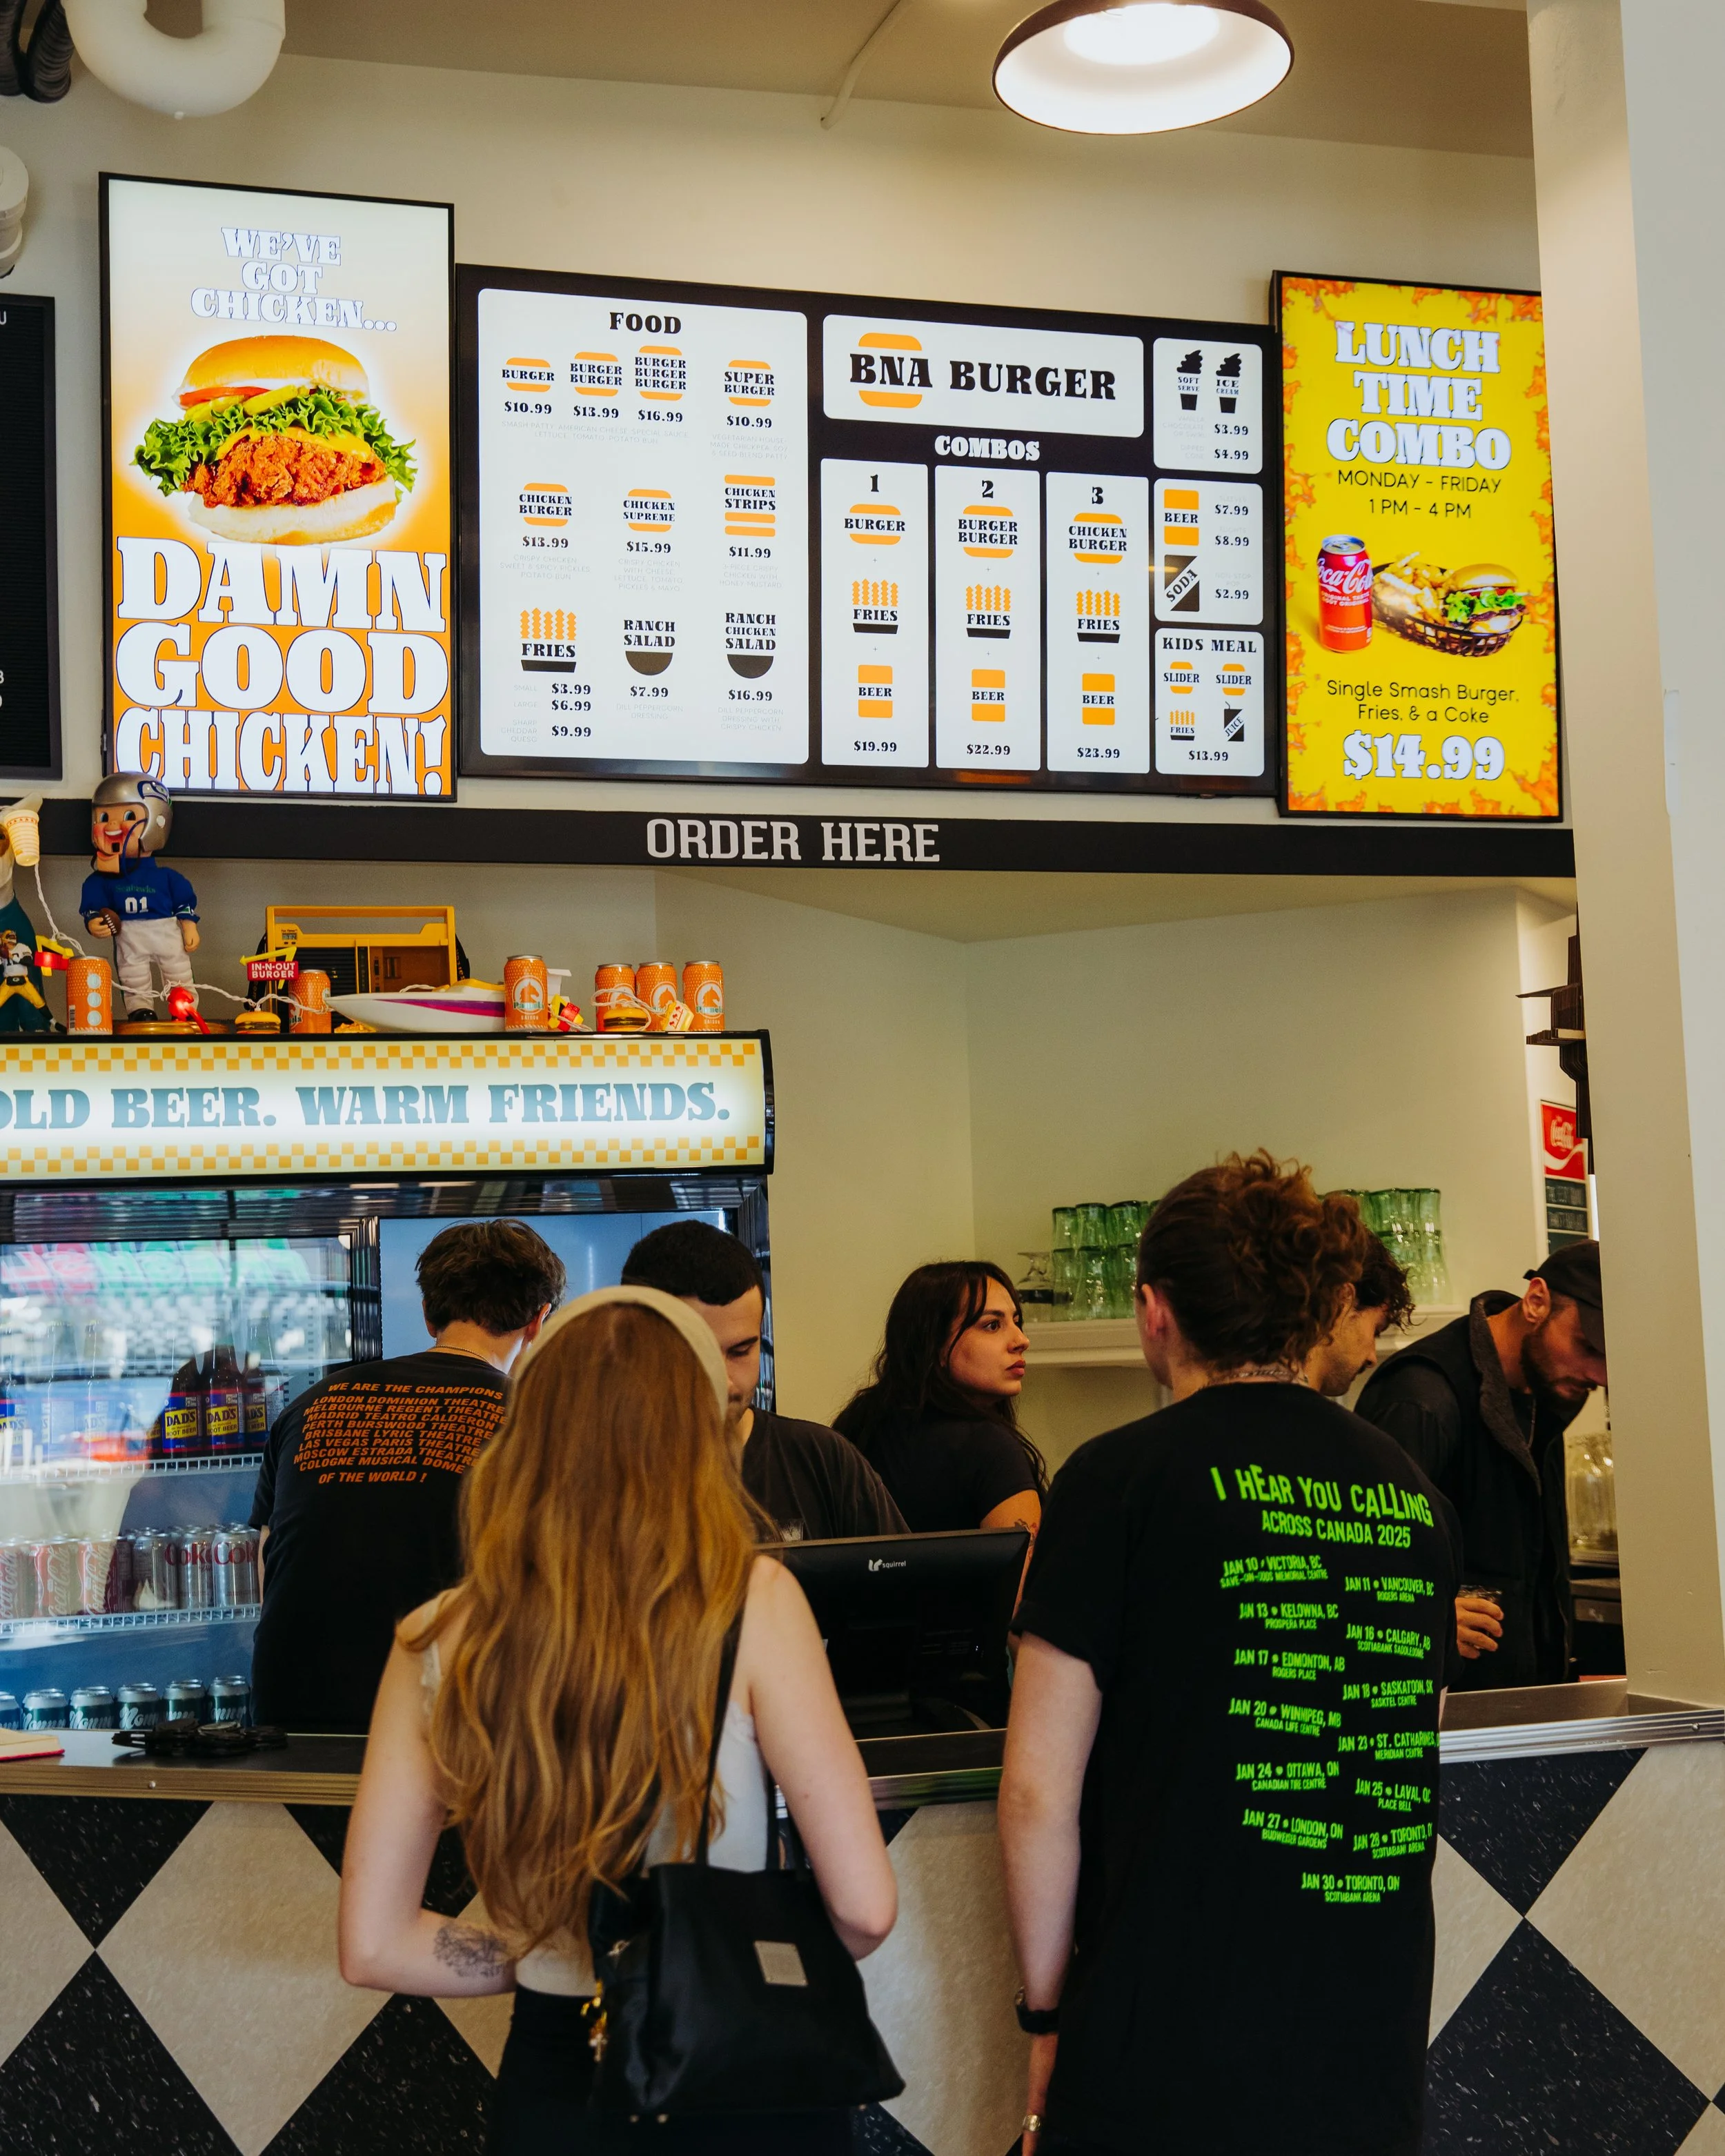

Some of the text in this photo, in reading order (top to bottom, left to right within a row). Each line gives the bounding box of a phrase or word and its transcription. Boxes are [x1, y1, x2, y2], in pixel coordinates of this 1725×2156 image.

[221, 226, 341, 266] WE'VE
[241, 261, 324, 295] GOT
[191, 288, 397, 333] CHICKEN...
[609, 312, 682, 335] FOOD
[1334, 319, 1501, 373] LUNCH
[570, 363, 622, 375] BURGER
[635, 357, 686, 368] BURGER
[502, 369, 555, 382] BURGER
[635, 367, 687, 379] BURGER
[724, 371, 774, 385] SUPER
[849, 353, 1116, 400] BNA BURGER
[570, 374, 622, 386] BURGER
[635, 378, 687, 390] BURGER
[1216, 379, 1239, 388] ICE
[724, 384, 775, 396] BURGER
[1353, 370, 1483, 422] TIME
[504, 400, 552, 415] $10.99
[573, 405, 619, 419] $13.99
[638, 409, 683, 422] $16.99
[727, 415, 772, 428] $10.99
[1214, 424, 1249, 435] $3.99
[934, 435, 1040, 461] COMBOS
[1326, 417, 1512, 471] COMBO
[1214, 448, 1249, 460] $4.99
[870, 474, 880, 493] 1
[1338, 469, 1420, 488] MONDAY
[1441, 475, 1501, 493] FRIDAY
[724, 487, 776, 498] CHICKEN
[981, 479, 994, 499] 2
[1092, 486, 1104, 505] 3
[519, 494, 572, 505] CHICKEN
[623, 500, 675, 511] CHICKEN
[724, 498, 776, 511] STRIPS
[519, 504, 572, 516] BURGER
[1214, 504, 1249, 516] $7.99
[1369, 498, 1374, 514] 1
[1381, 499, 1408, 515] PM
[1429, 502, 1439, 517] 4
[1445, 502, 1471, 518] PM
[623, 511, 676, 522] SUPREME
[1164, 512, 1199, 524] BEER
[844, 518, 905, 532] BURGER
[958, 519, 1018, 533] BURGER
[1068, 525, 1127, 538] CHICKEN
[522, 535, 569, 548] $13.99
[958, 531, 1018, 545] BURGER
[1215, 535, 1250, 546] $8.99
[627, 540, 671, 553] $15.99
[1069, 538, 1127, 552] BURGER
[729, 546, 771, 558] $11.99
[117, 537, 448, 633] DAMN
[1166, 569, 1198, 602] SODA
[1215, 589, 1249, 600] $2.99
[725, 612, 776, 625] RANCH
[853, 609, 898, 622] FRIES
[967, 613, 1010, 626] FRIES
[623, 620, 676, 632] RANCH
[1077, 618, 1120, 631] FRIES
[725, 626, 776, 637] CHICKEN
[624, 634, 676, 647] SALAD
[725, 637, 776, 651] SALAD
[1163, 637, 1257, 653] KIDS MEAL
[522, 643, 575, 658] FRIES
[115, 621, 448, 715] GOOD
[1163, 672, 1200, 683] SLIDER
[1216, 674, 1252, 685] SLIDER
[551, 682, 591, 695] $3.99
[630, 685, 669, 698] $7.99
[858, 686, 892, 697] BEER
[1327, 680, 1383, 702] Single
[1389, 682, 1450, 699] Smash
[728, 689, 773, 702] $16.99
[972, 691, 1005, 701] BEER
[1082, 695, 1114, 705] BEER
[551, 699, 591, 711] $6.99
[1359, 704, 1489, 723] Fries, & a Coke
[551, 725, 591, 738] $9.99
[1225, 716, 1244, 737] JUICE
[115, 706, 448, 796] CHICKEN!
[854, 740, 897, 752] $19.99
[967, 743, 1011, 755] $22.99
[1077, 746, 1121, 759] $23.99
[1188, 750, 1229, 762] $13.99
[1342, 729, 1506, 781] $14.99
[647, 818, 940, 862] ORDER HERE
[125, 896, 149, 913] 01
[251, 962, 295, 971] IN-N-OUT
[110, 1087, 277, 1129] BEER.
[295, 1083, 469, 1126] WARM
[487, 1081, 730, 1124] FRIENDS.
[328, 1383, 503, 1400] WE ARE THE CHAMPIONS
[313, 1396, 506, 1414] LONDON DOMINION THEATRE
[166, 1411, 196, 1427] DAD'S
[306, 1412, 495, 1430] MADRID TEATRO CALDERON
[304, 1430, 482, 1446] BRISBANE LYRIC THEATRE
[319, 1471, 427, 1484] OF THE WORLD !
[1210, 1464, 1434, 1527] I HEAR YOU CALLING
[1261, 1510, 1411, 1549] ACROSS CANADA 2025
[882, 1561, 906, 1569] squirrel
[1239, 1602, 1339, 1619] JAN 13 KELOWNA, BC
[1234, 1648, 1346, 1672] JAN 17 EDMONTON, AB
[1272, 1666, 1317, 1681] ROGERS PLACE
[1301, 1872, 1400, 1893] JAN 30 TORONTO, ON
